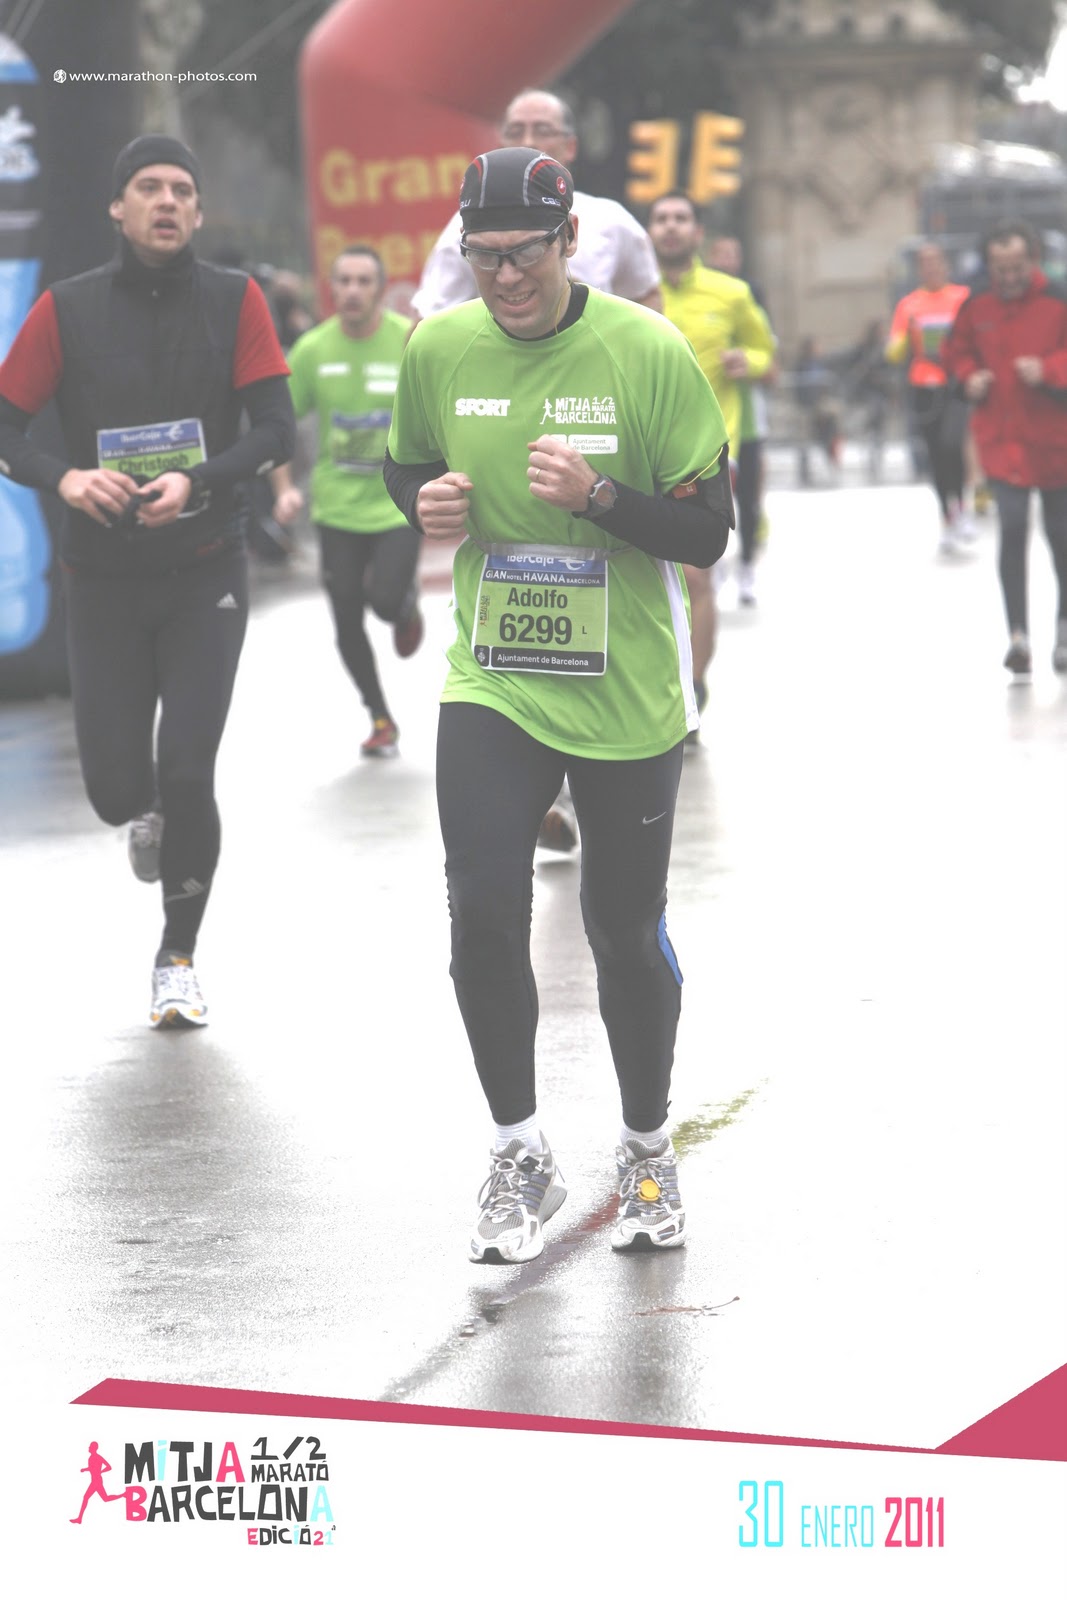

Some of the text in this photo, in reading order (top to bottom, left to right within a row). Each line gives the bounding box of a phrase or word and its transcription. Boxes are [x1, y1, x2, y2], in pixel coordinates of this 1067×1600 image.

[455, 397, 511, 416] SPORT
[591, 396, 615, 405] 1/2
[555, 411, 617, 424] BARCELONA
[523, 572, 566, 583] HAVANA
[506, 587, 568, 609] Adolfo
[499, 613, 588, 645] 6299 L
[497, 653, 589, 666] Ajuntament de Barcelona
